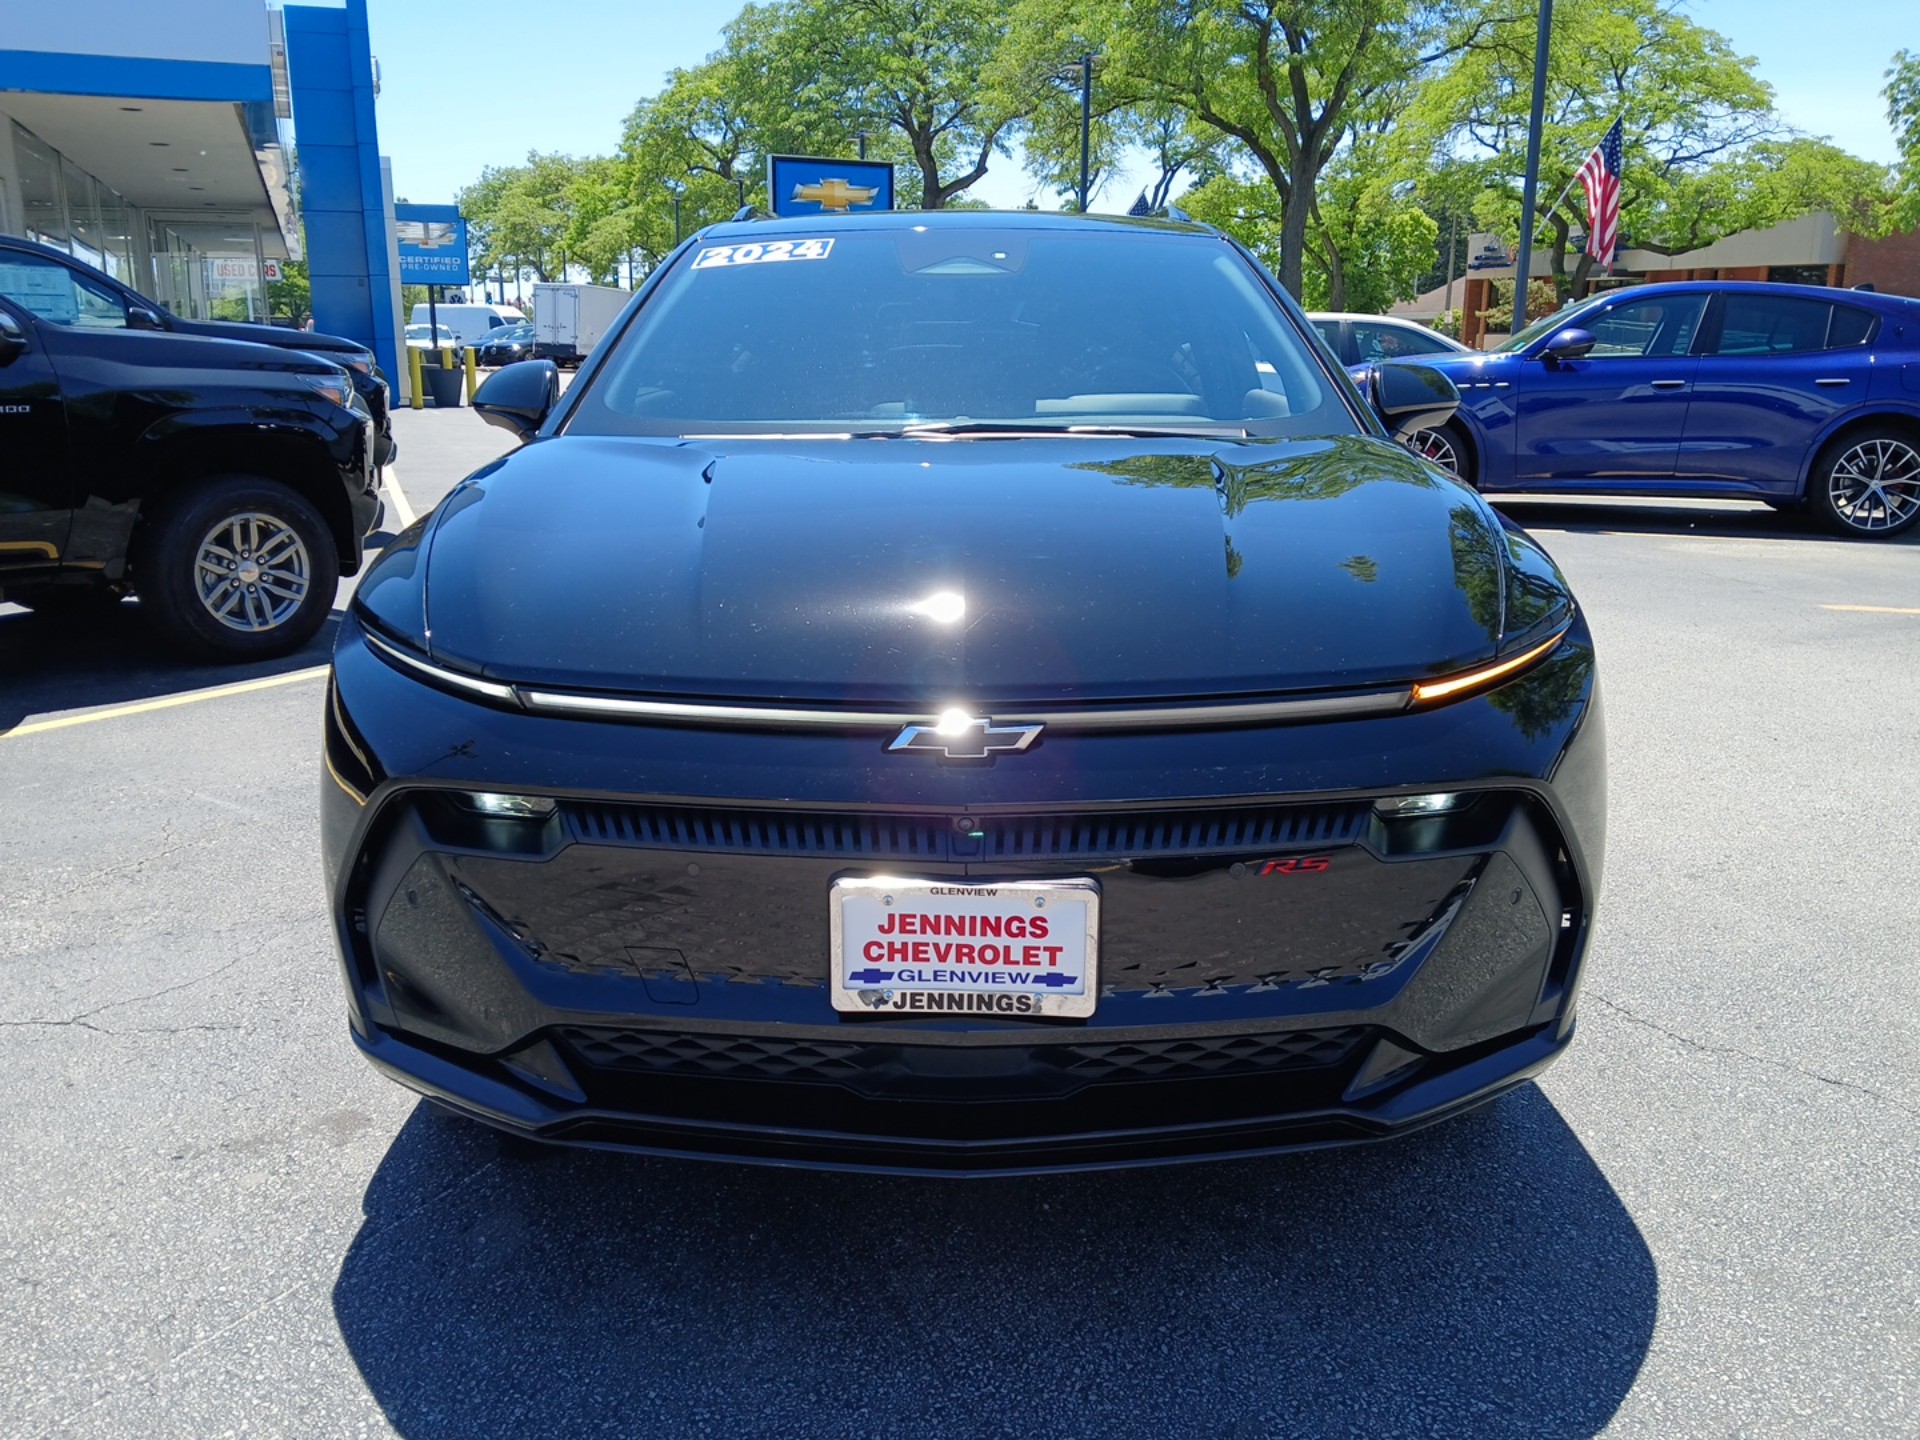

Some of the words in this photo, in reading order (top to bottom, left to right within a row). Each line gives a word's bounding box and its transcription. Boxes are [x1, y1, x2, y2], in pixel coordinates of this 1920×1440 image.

[399, 256, 461, 265] CERTIFIED
[700, 240, 824, 267] 2024
[217, 263, 245, 277] USED
[248, 263, 277, 277] CRS
[1261, 856, 1332, 877] RS
[930, 887, 998, 897] GLENVIEW
[877, 913, 1049, 939] JENNINGS
[863, 940, 1064, 967] CHEVROLET
[897, 969, 1031, 985] GLENVIEW
[893, 992, 1032, 1013] JENNINGS
